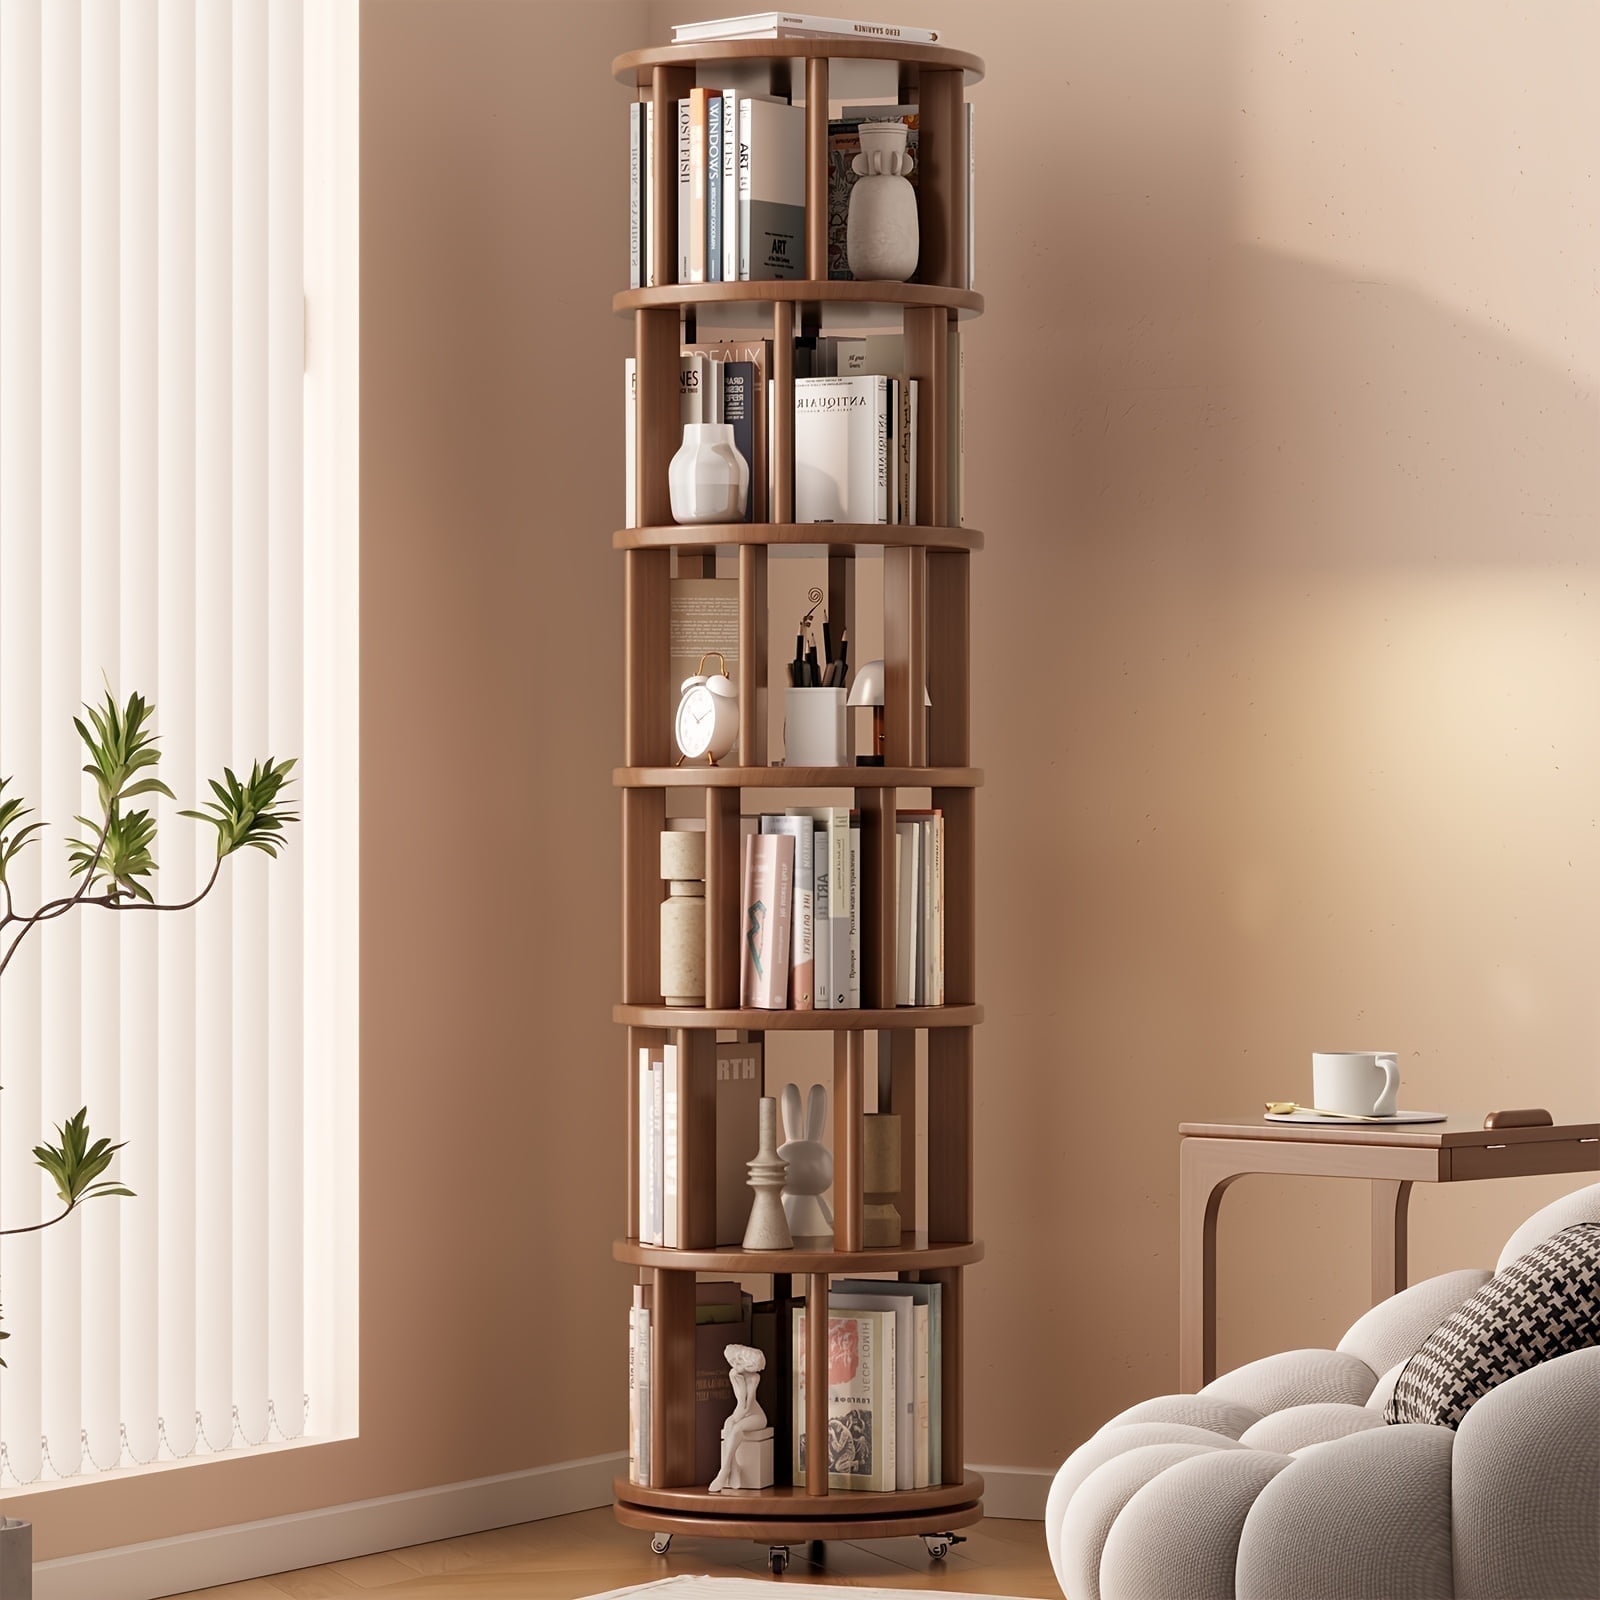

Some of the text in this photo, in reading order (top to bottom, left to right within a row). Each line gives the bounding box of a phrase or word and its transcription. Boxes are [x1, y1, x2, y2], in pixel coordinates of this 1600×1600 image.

[853, 24, 900, 37] EERO SAARINEN
[681, 104, 690, 184] LOST FISH
[709, 103, 719, 179] WINDOWS
[740, 143, 749, 171] ART
[771, 239, 786, 255] ART
[803, 894, 811, 909] THE
